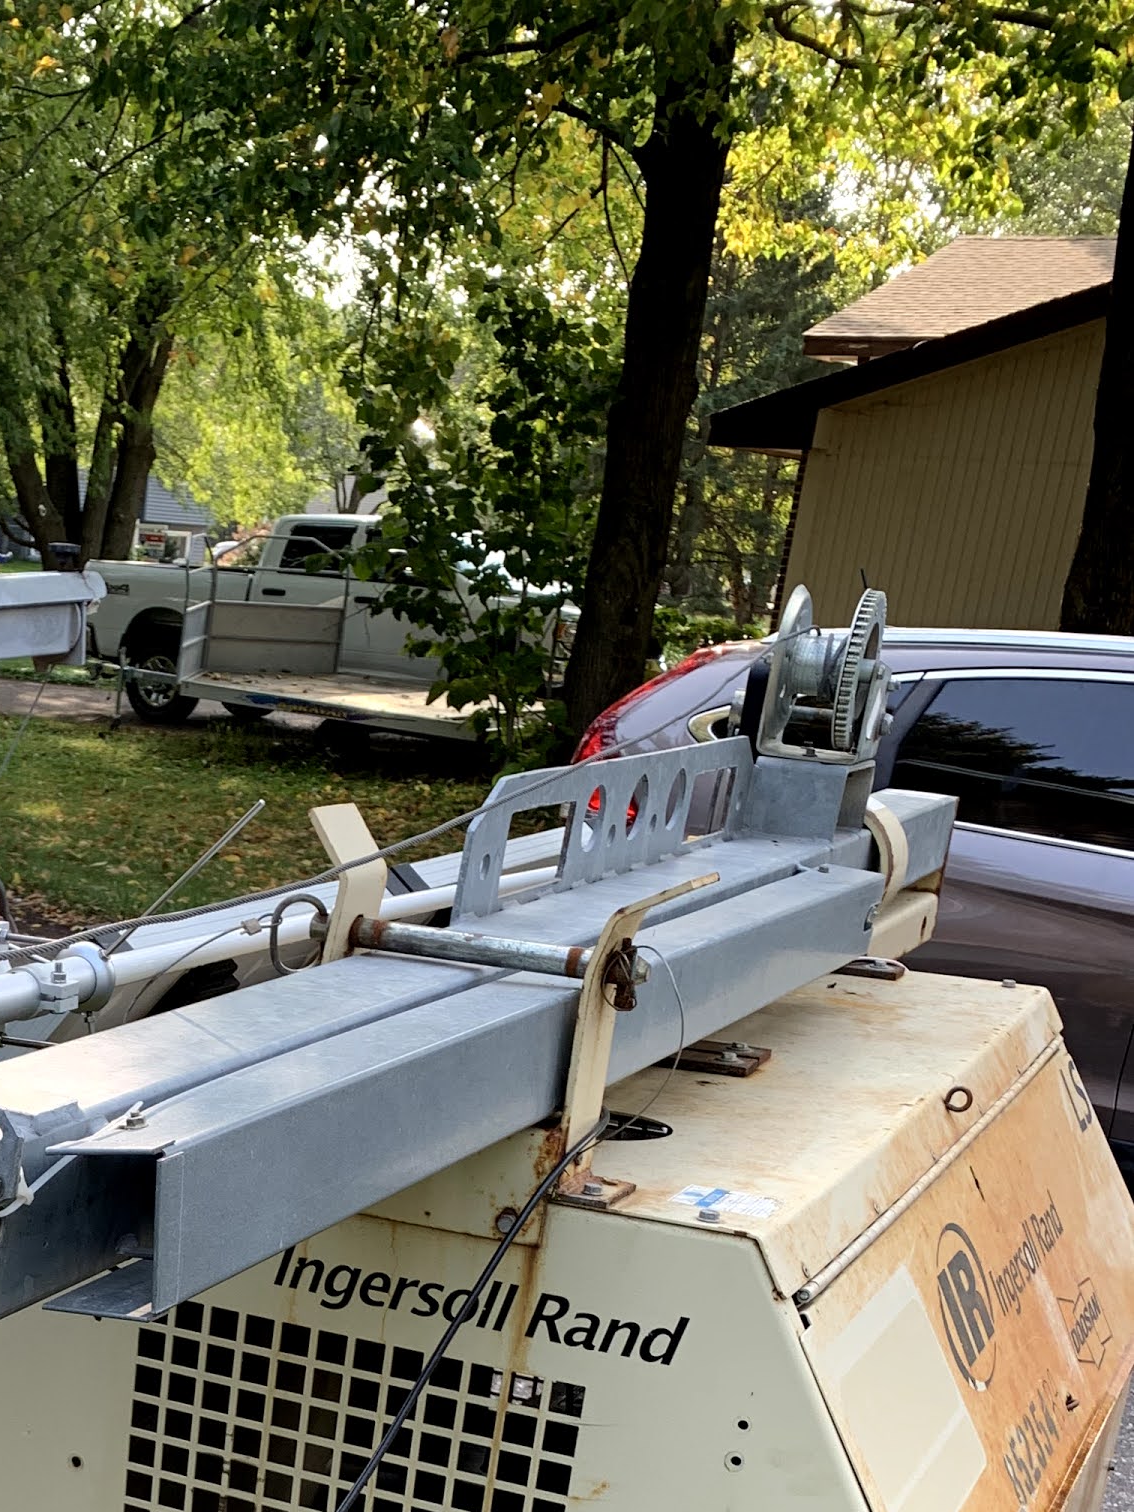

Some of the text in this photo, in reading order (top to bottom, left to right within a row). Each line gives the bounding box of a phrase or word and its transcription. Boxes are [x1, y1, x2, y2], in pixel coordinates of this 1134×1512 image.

[272, 1245, 690, 1366] Ingersoll Rand
[937, 1250, 995, 1367] IR
[988, 1188, 1064, 1317] Ingersoll Rand
[1070, 1292, 1102, 1354] DOOSAN
